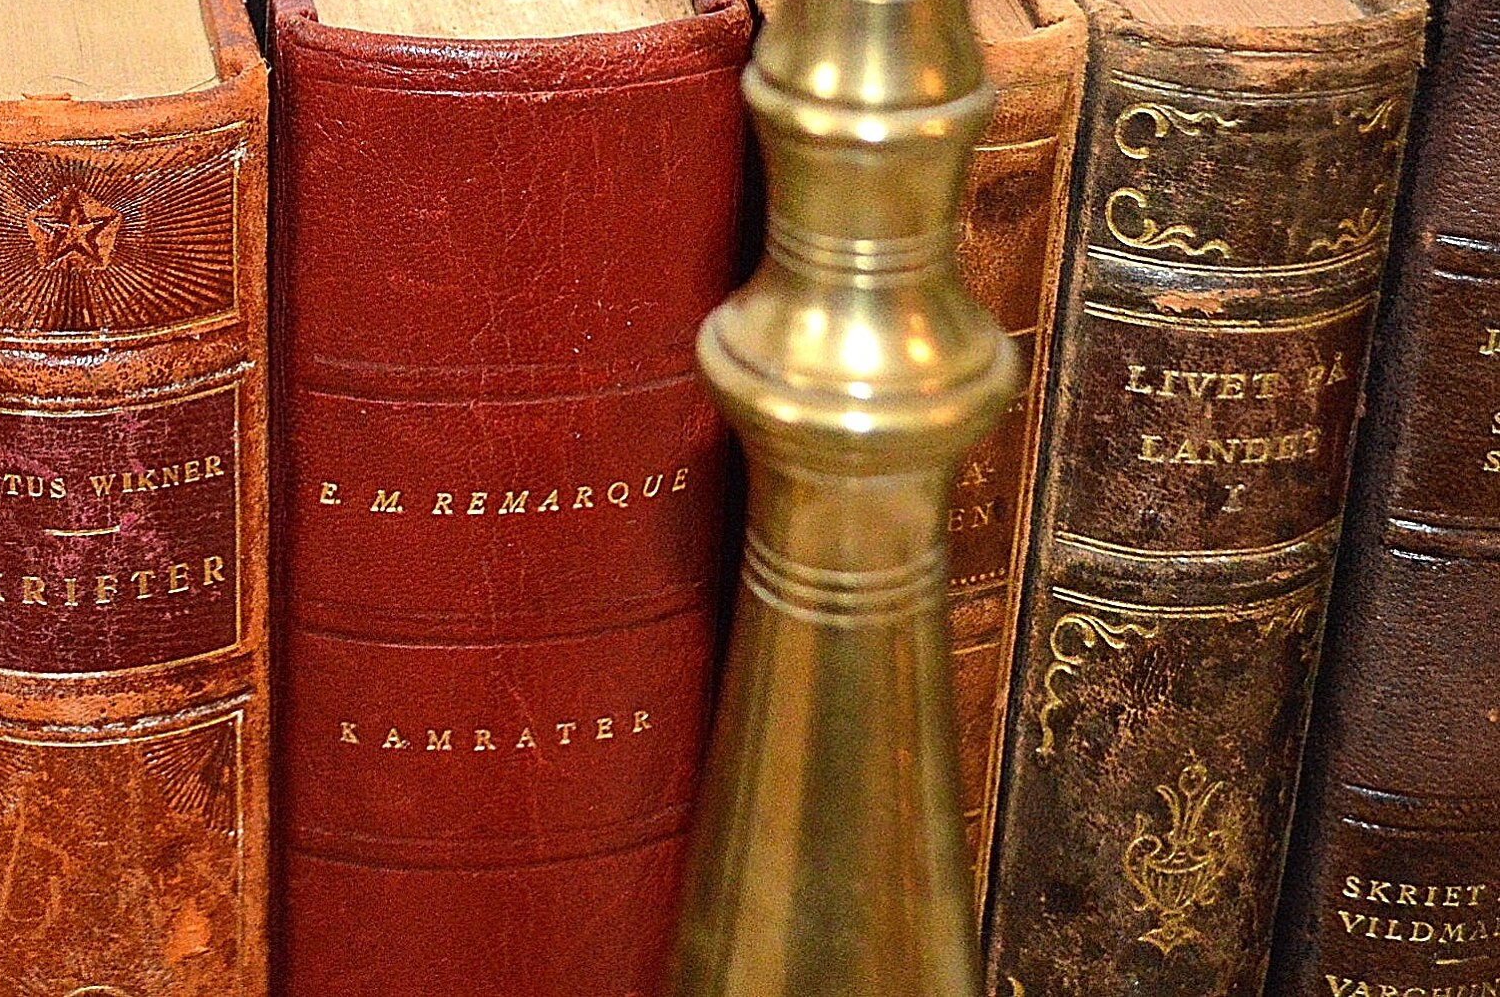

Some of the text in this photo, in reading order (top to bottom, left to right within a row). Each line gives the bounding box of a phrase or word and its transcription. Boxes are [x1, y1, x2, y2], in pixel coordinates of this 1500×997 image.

[1125, 365, 1283, 399] LIVET
[1137, 428, 1321, 464] LANDET
[90, 455, 225, 497] WIKNER
[320, 467, 688, 515] E. M. REMARQUE
[340, 710, 653, 751] KAMRATER
[1342, 876, 1486, 907] SKRIET
